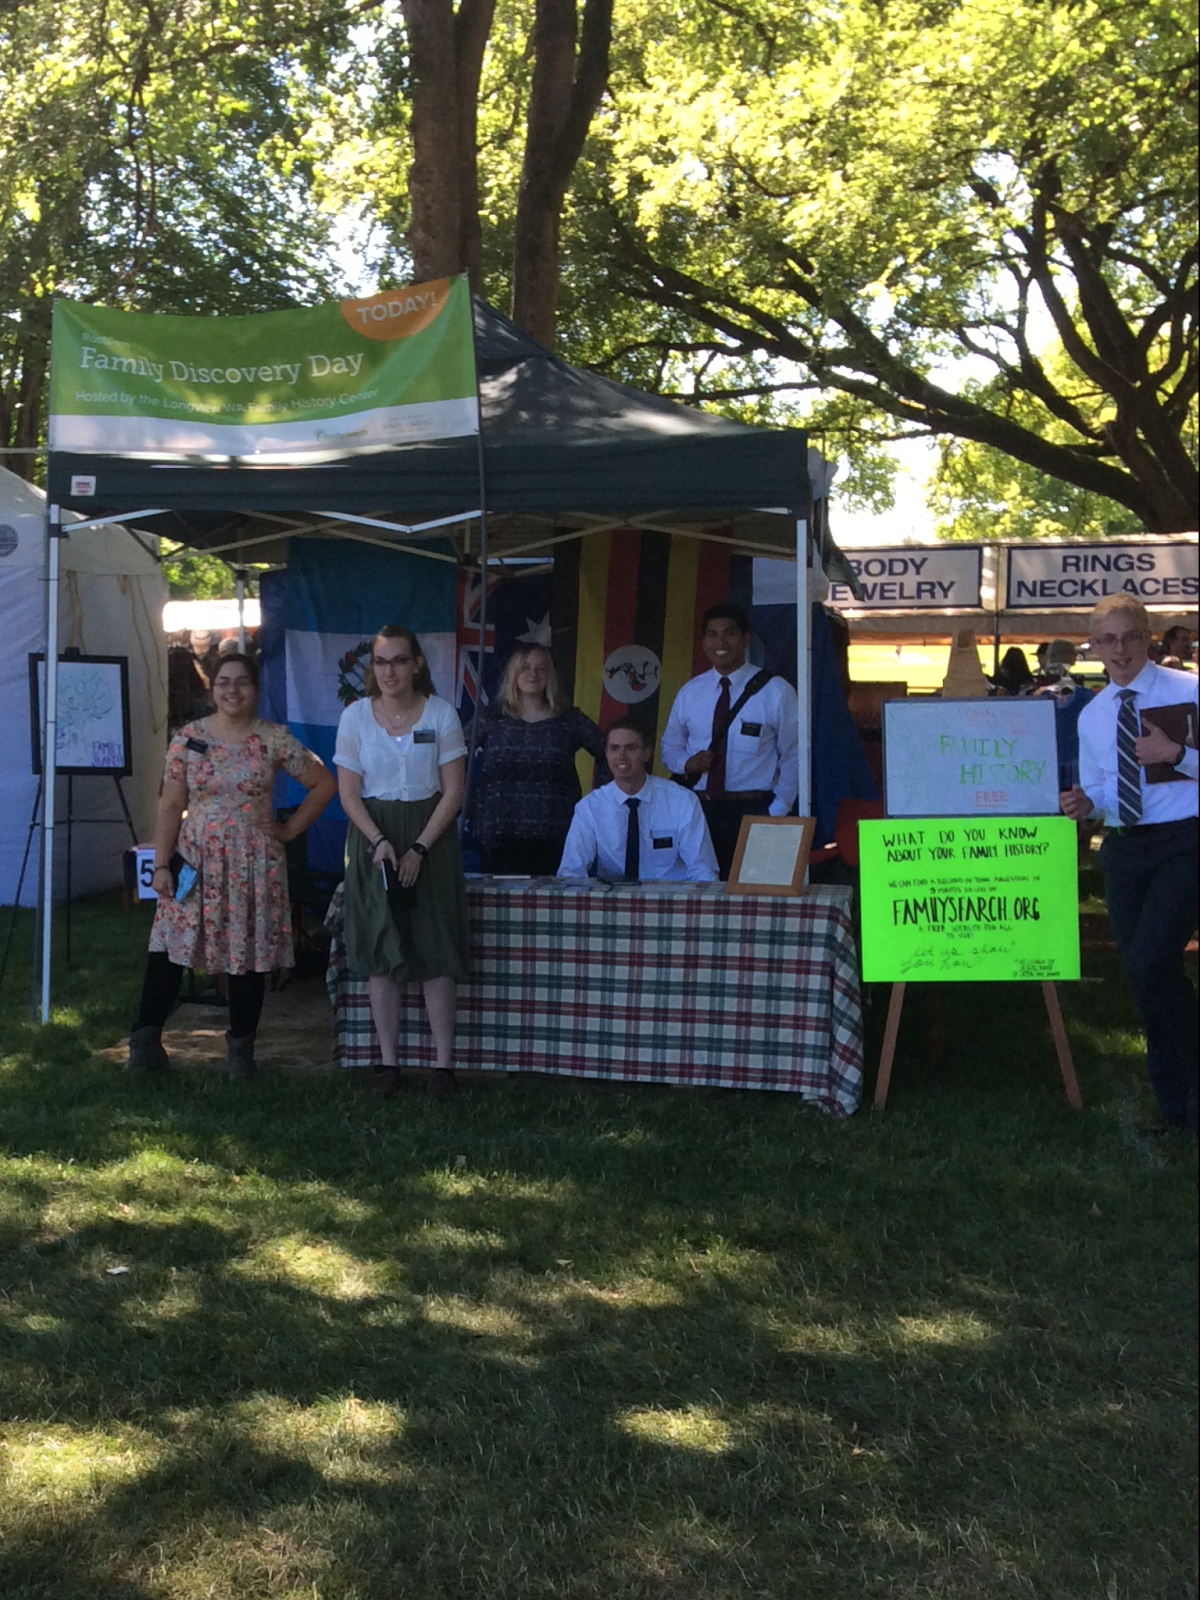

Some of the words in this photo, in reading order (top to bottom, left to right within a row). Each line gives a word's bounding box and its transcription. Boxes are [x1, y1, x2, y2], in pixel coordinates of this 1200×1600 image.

[356, 291, 436, 324] TODAY!
[80, 346, 164, 382] Family
[169, 360, 302, 385] Discovery
[308, 353, 364, 377] Day
[75, 391, 118, 402] Hosted
[119, 391, 136, 405] by
[139, 394, 159, 406] the
[247, 402, 287, 414] Family
[291, 396, 336, 410] History
[339, 388, 379, 404] Center
[849, 557, 929, 577] BODY
[1062, 553, 1156, 573] RINGS
[831, 581, 956, 601] EWELRY
[1016, 577, 1199, 598] NECKLACES
[939, 734, 1018, 758] FAMILY
[960, 759, 1047, 785] HISTORY
[974, 790, 1007, 803] FREE
[882, 831, 925, 847] WHAT
[939, 830, 955, 844] DO
[963, 829, 986, 841] YOU
[998, 826, 1038, 840] KNOW
[887, 847, 922, 863] ABOUT
[928, 846, 956, 860] YOUR
[962, 844, 998, 859] FAMILY
[1004, 842, 1050, 857] HISTORY?
[141, 859, 154, 888] 5
